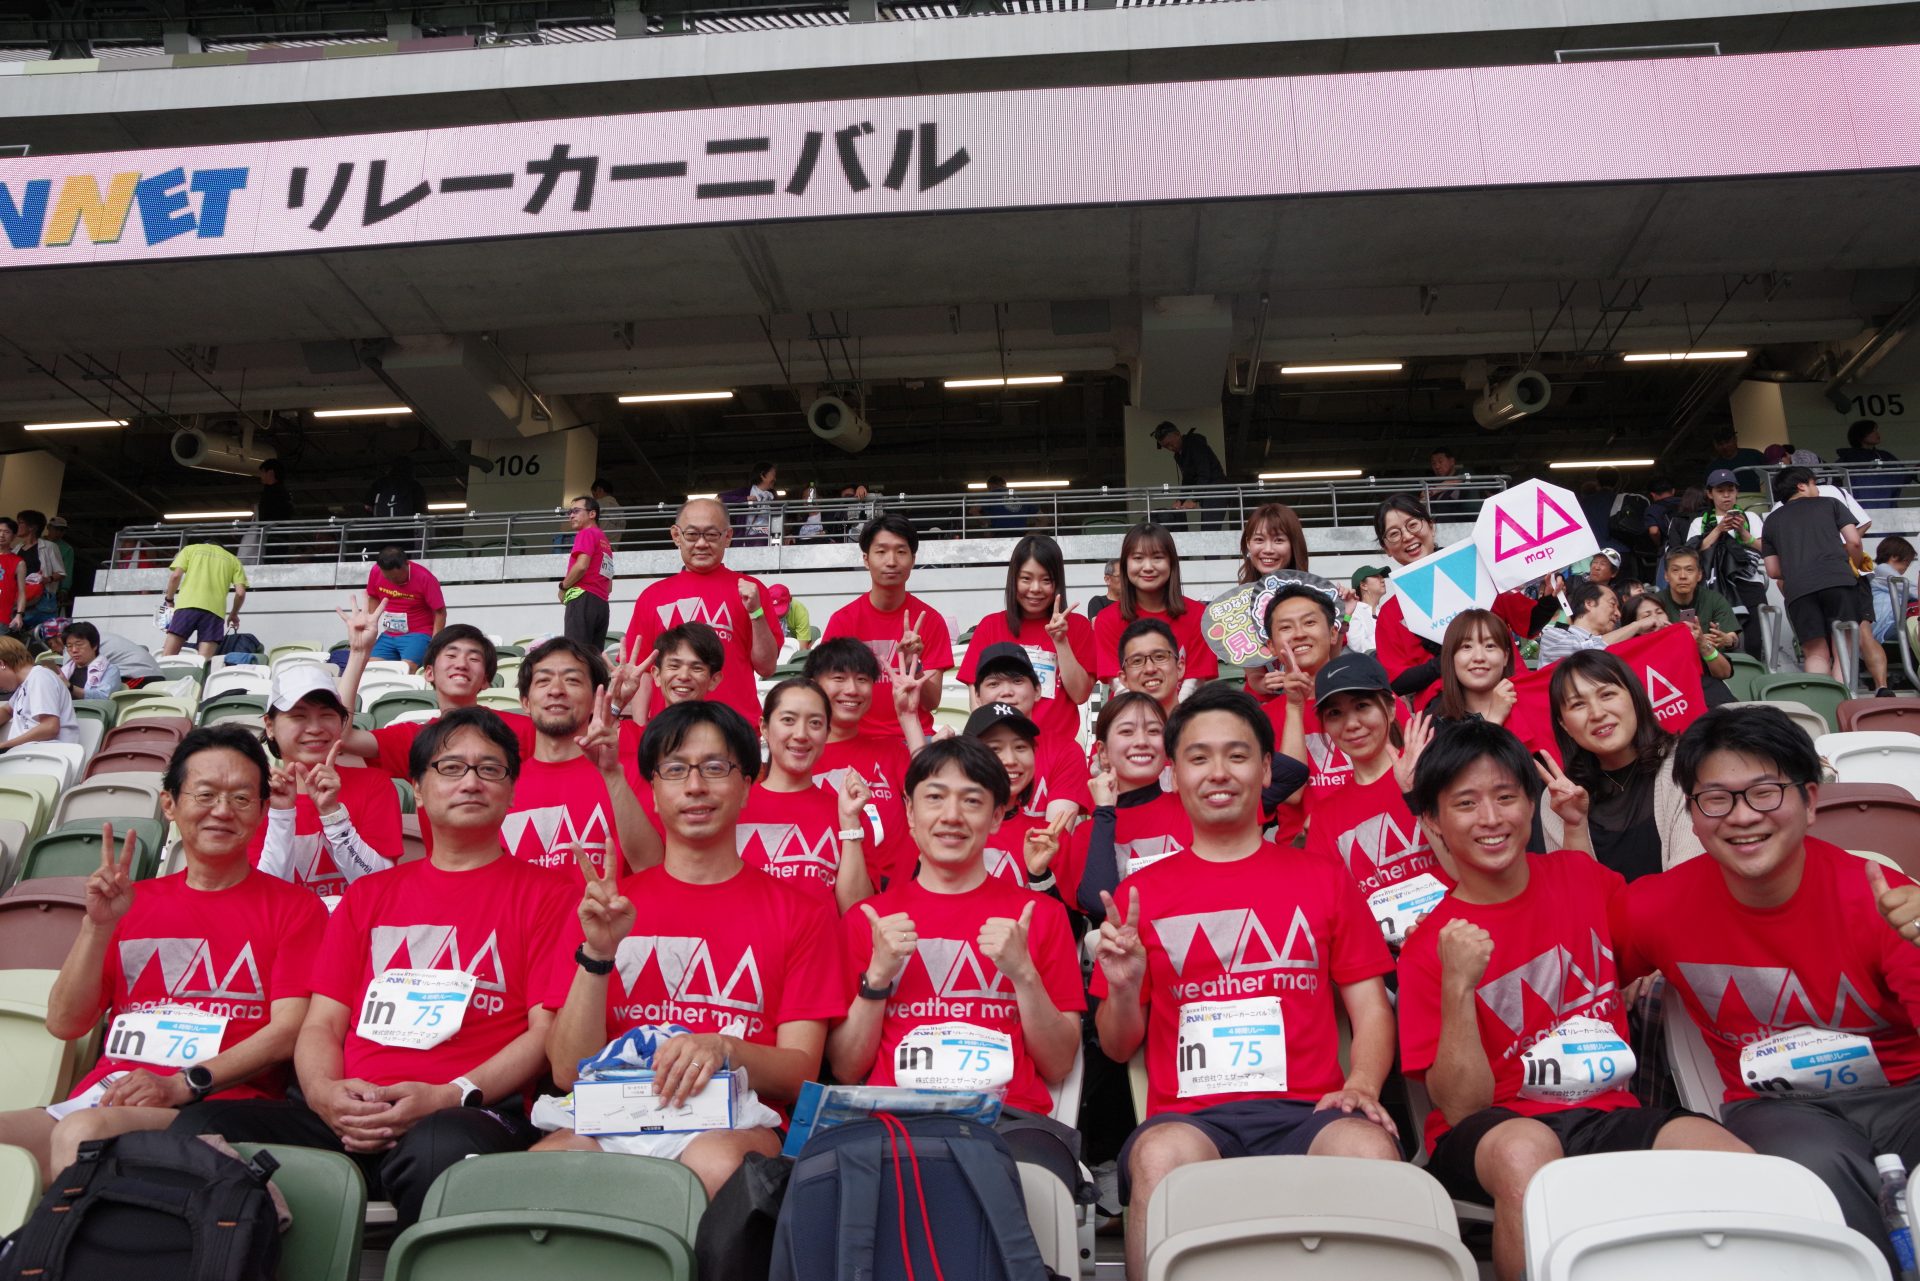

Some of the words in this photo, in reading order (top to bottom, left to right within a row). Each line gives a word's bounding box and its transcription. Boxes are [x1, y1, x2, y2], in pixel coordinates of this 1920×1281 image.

[286, 121, 972, 232] リレーカーニバル
[1852, 393, 1905, 417] 105
[495, 454, 541, 477] 106
[1523, 546, 1556, 566] map
[1169, 972, 1267, 1000] weather
[1273, 972, 1319, 996] map
[363, 990, 397, 1025] in
[413, 1005, 445, 1027] 75
[467, 993, 505, 1016] ap
[613, 999, 707, 1024] weather
[1186, 1012, 1223, 1024] RUNNET
[110, 1020, 146, 1056] in
[165, 1034, 199, 1060] 76
[1756, 1041, 1798, 1058] RUNNET
[899, 1042, 934, 1070] in
[957, 1049, 991, 1072] 75
[1179, 1035, 1207, 1073] in
[1229, 1040, 1264, 1067] 75
[1523, 1051, 1562, 1086] in
[1582, 1056, 1616, 1084] 19
[1746, 1070, 1795, 1092] in
[1814, 1064, 1858, 1090] 76
